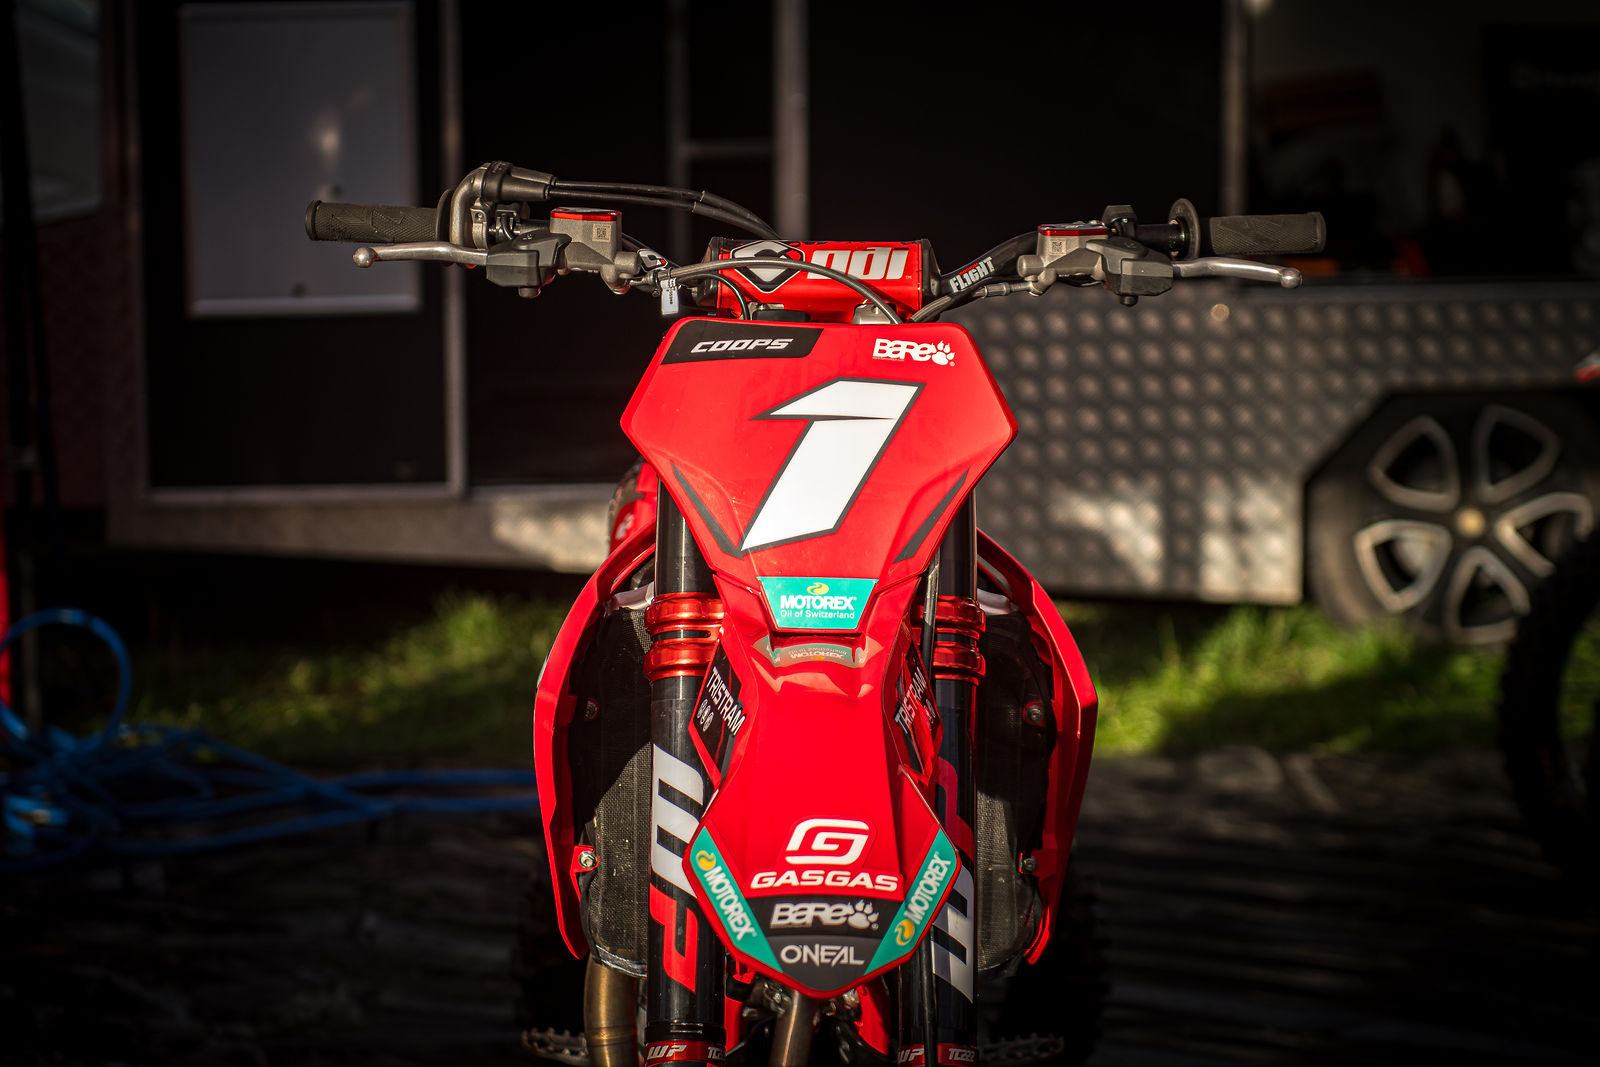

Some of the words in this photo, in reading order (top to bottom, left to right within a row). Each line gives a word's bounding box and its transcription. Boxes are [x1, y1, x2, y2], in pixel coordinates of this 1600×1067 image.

[690, 338, 794, 353] COOPS
[739, 376, 926, 556] 1
[780, 595, 856, 610] MOTOREX
[780, 609, 792, 617] Oil
[794, 609, 804, 617] of
[805, 610, 855, 619] Switzerland
[706, 666, 746, 736] TRISTRAM
[895, 666, 927, 734] TRISTRAM
[750, 870, 898, 891] GASGAS
[905, 851, 952, 926] MOTOREX
[703, 865, 754, 941] MOTOREX
[647, 1044, 687, 1060] WP
